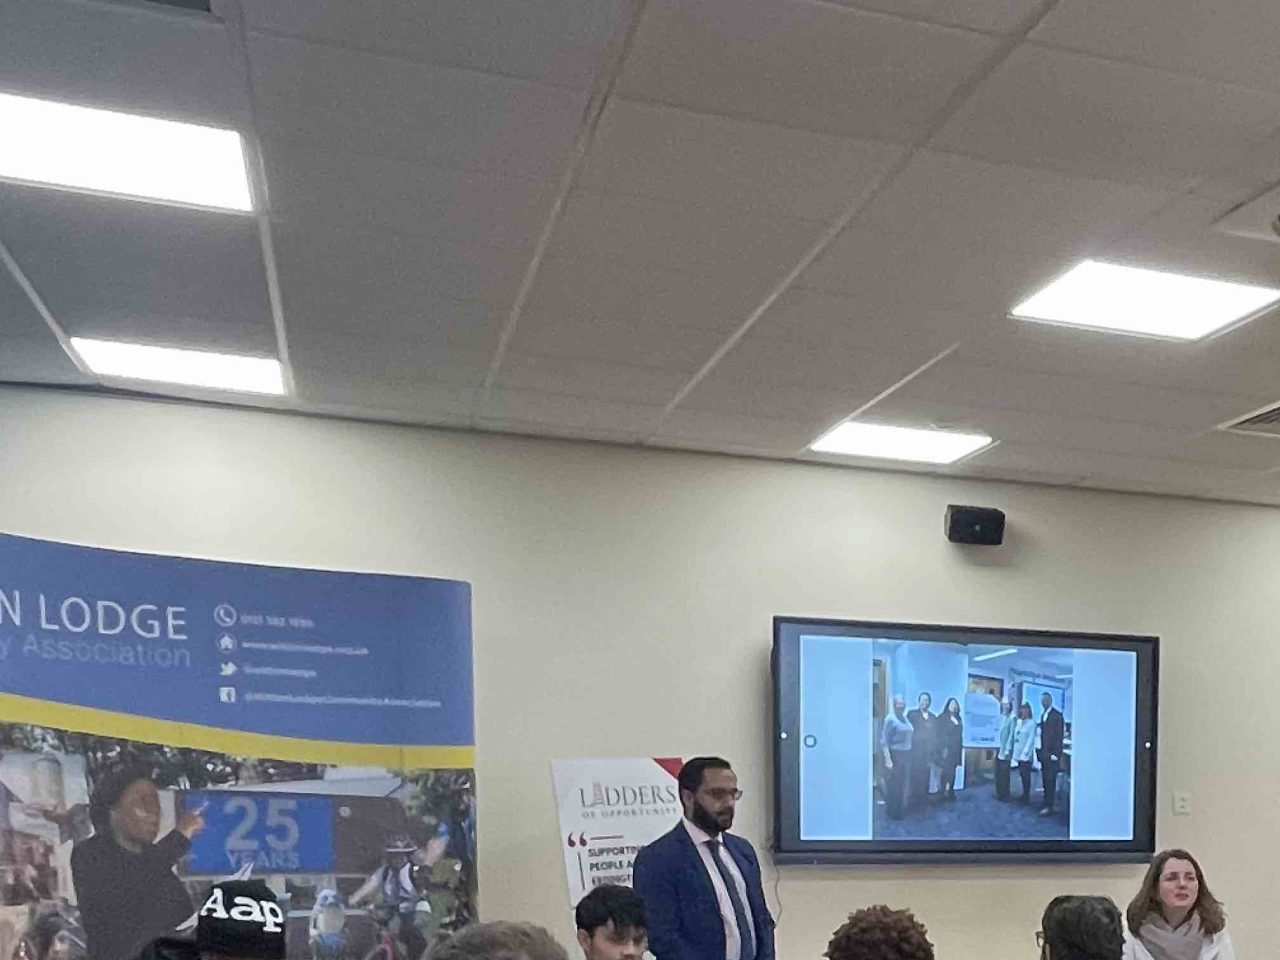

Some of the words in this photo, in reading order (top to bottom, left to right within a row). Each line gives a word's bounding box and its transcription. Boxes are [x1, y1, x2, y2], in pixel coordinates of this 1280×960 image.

[40, 594, 188, 640] LODGE
[24, 634, 191, 668] Association
[223, 795, 299, 851] 25
[225, 850, 300, 869] YEARS
[589, 860, 623, 871] PEOPLE
[200, 888, 284, 933] Aap
